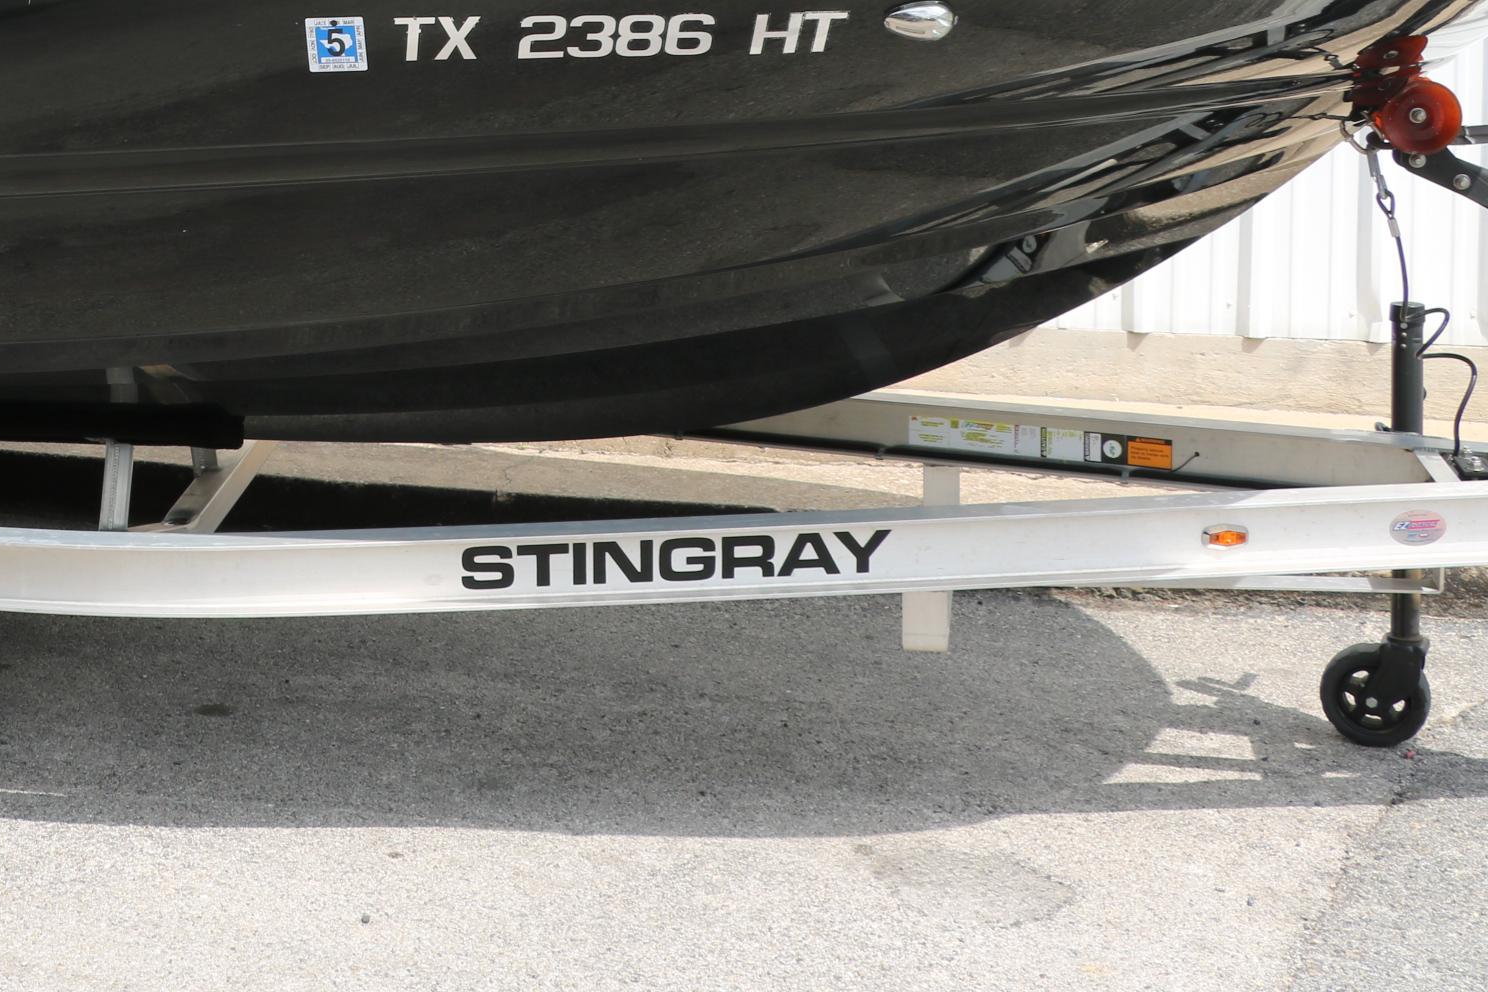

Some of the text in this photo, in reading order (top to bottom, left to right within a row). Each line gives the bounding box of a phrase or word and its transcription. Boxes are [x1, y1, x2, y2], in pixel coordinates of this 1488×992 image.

[327, 28, 346, 57] 5
[393, 10, 851, 61] TX 2386 HT
[460, 529, 892, 590] STINGRAY
